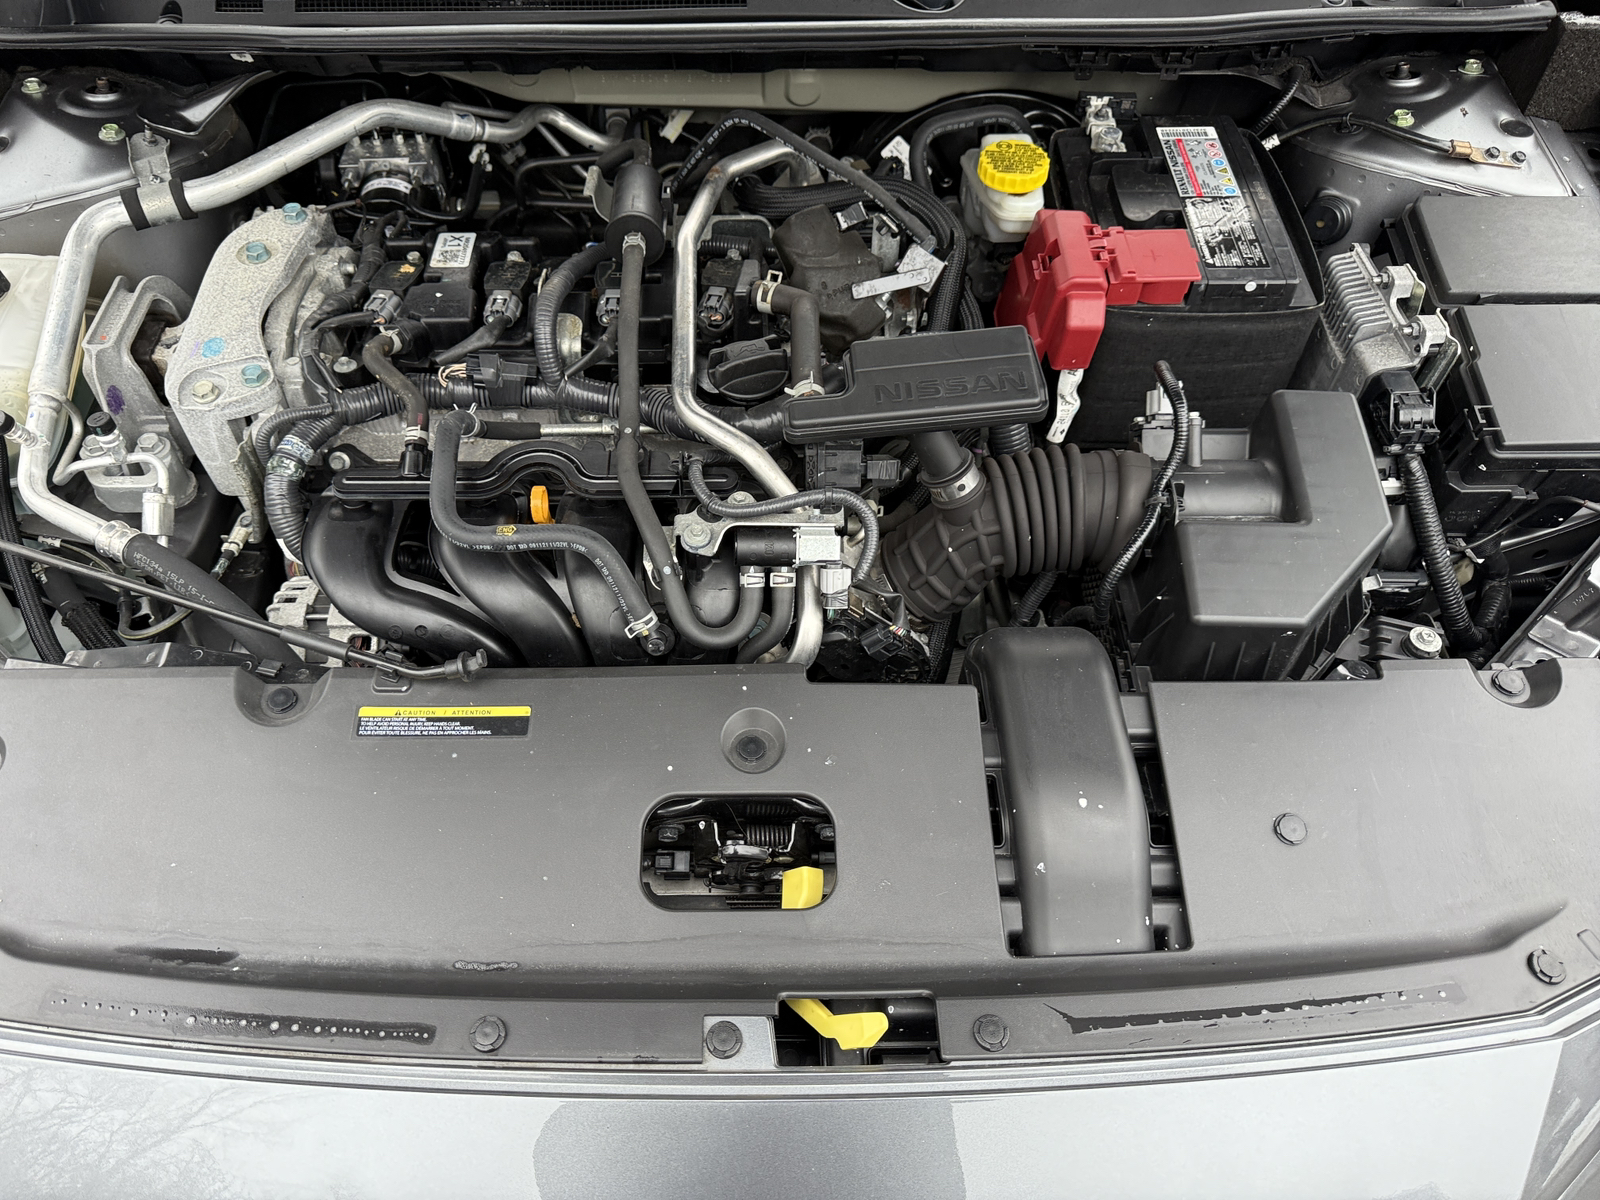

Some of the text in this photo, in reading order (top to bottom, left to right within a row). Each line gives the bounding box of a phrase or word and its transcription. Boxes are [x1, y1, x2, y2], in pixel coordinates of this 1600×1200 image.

[1163, 140, 1180, 168] NISSAN
[1173, 168, 1190, 195] RENAULT
[447, 234, 465, 247] X1
[874, 370, 1028, 404] NISSAN
[133, 551, 163, 572] HFC134a
[166, 570, 185, 584] 15LP
